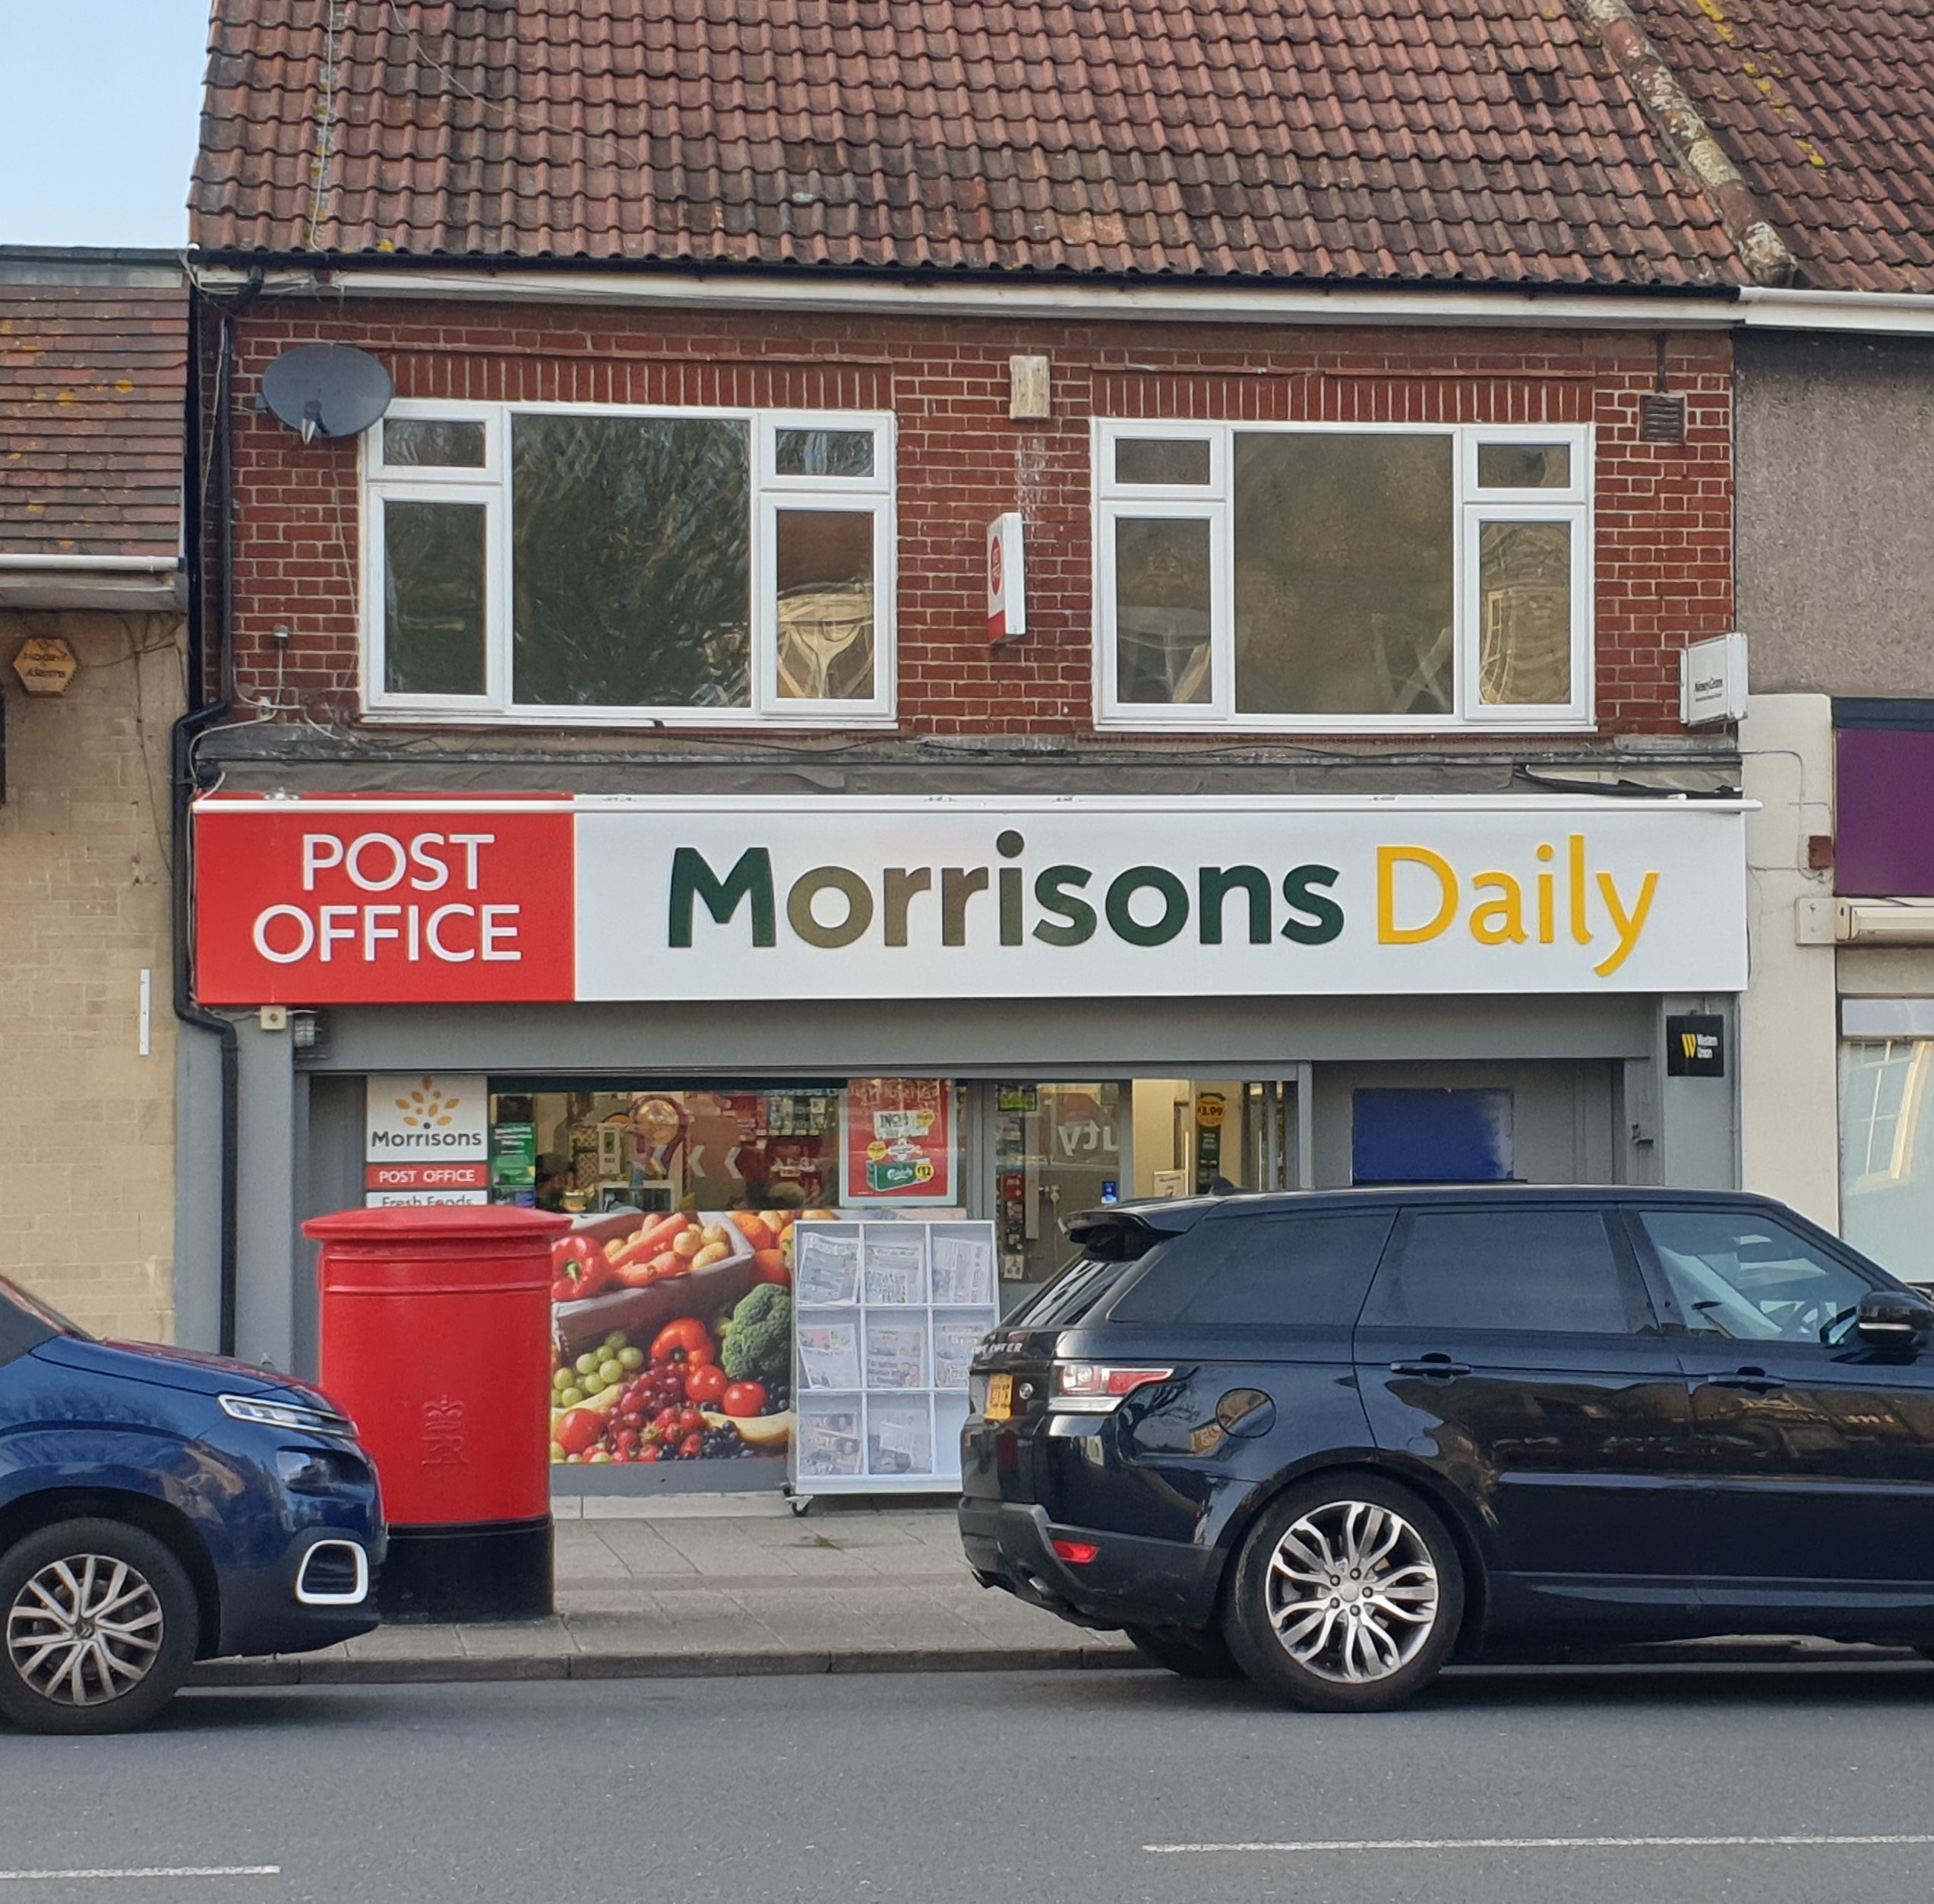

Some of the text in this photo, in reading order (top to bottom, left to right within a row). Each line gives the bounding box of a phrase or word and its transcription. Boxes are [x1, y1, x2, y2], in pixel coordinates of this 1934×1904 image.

[303, 833, 495, 891] POST
[668, 830, 1660, 978] Morrisons Daily
[253, 904, 522, 963] OFFICE
[371, 1122, 482, 1147] Morrisons
[379, 1169, 476, 1183] POST OFFICE
